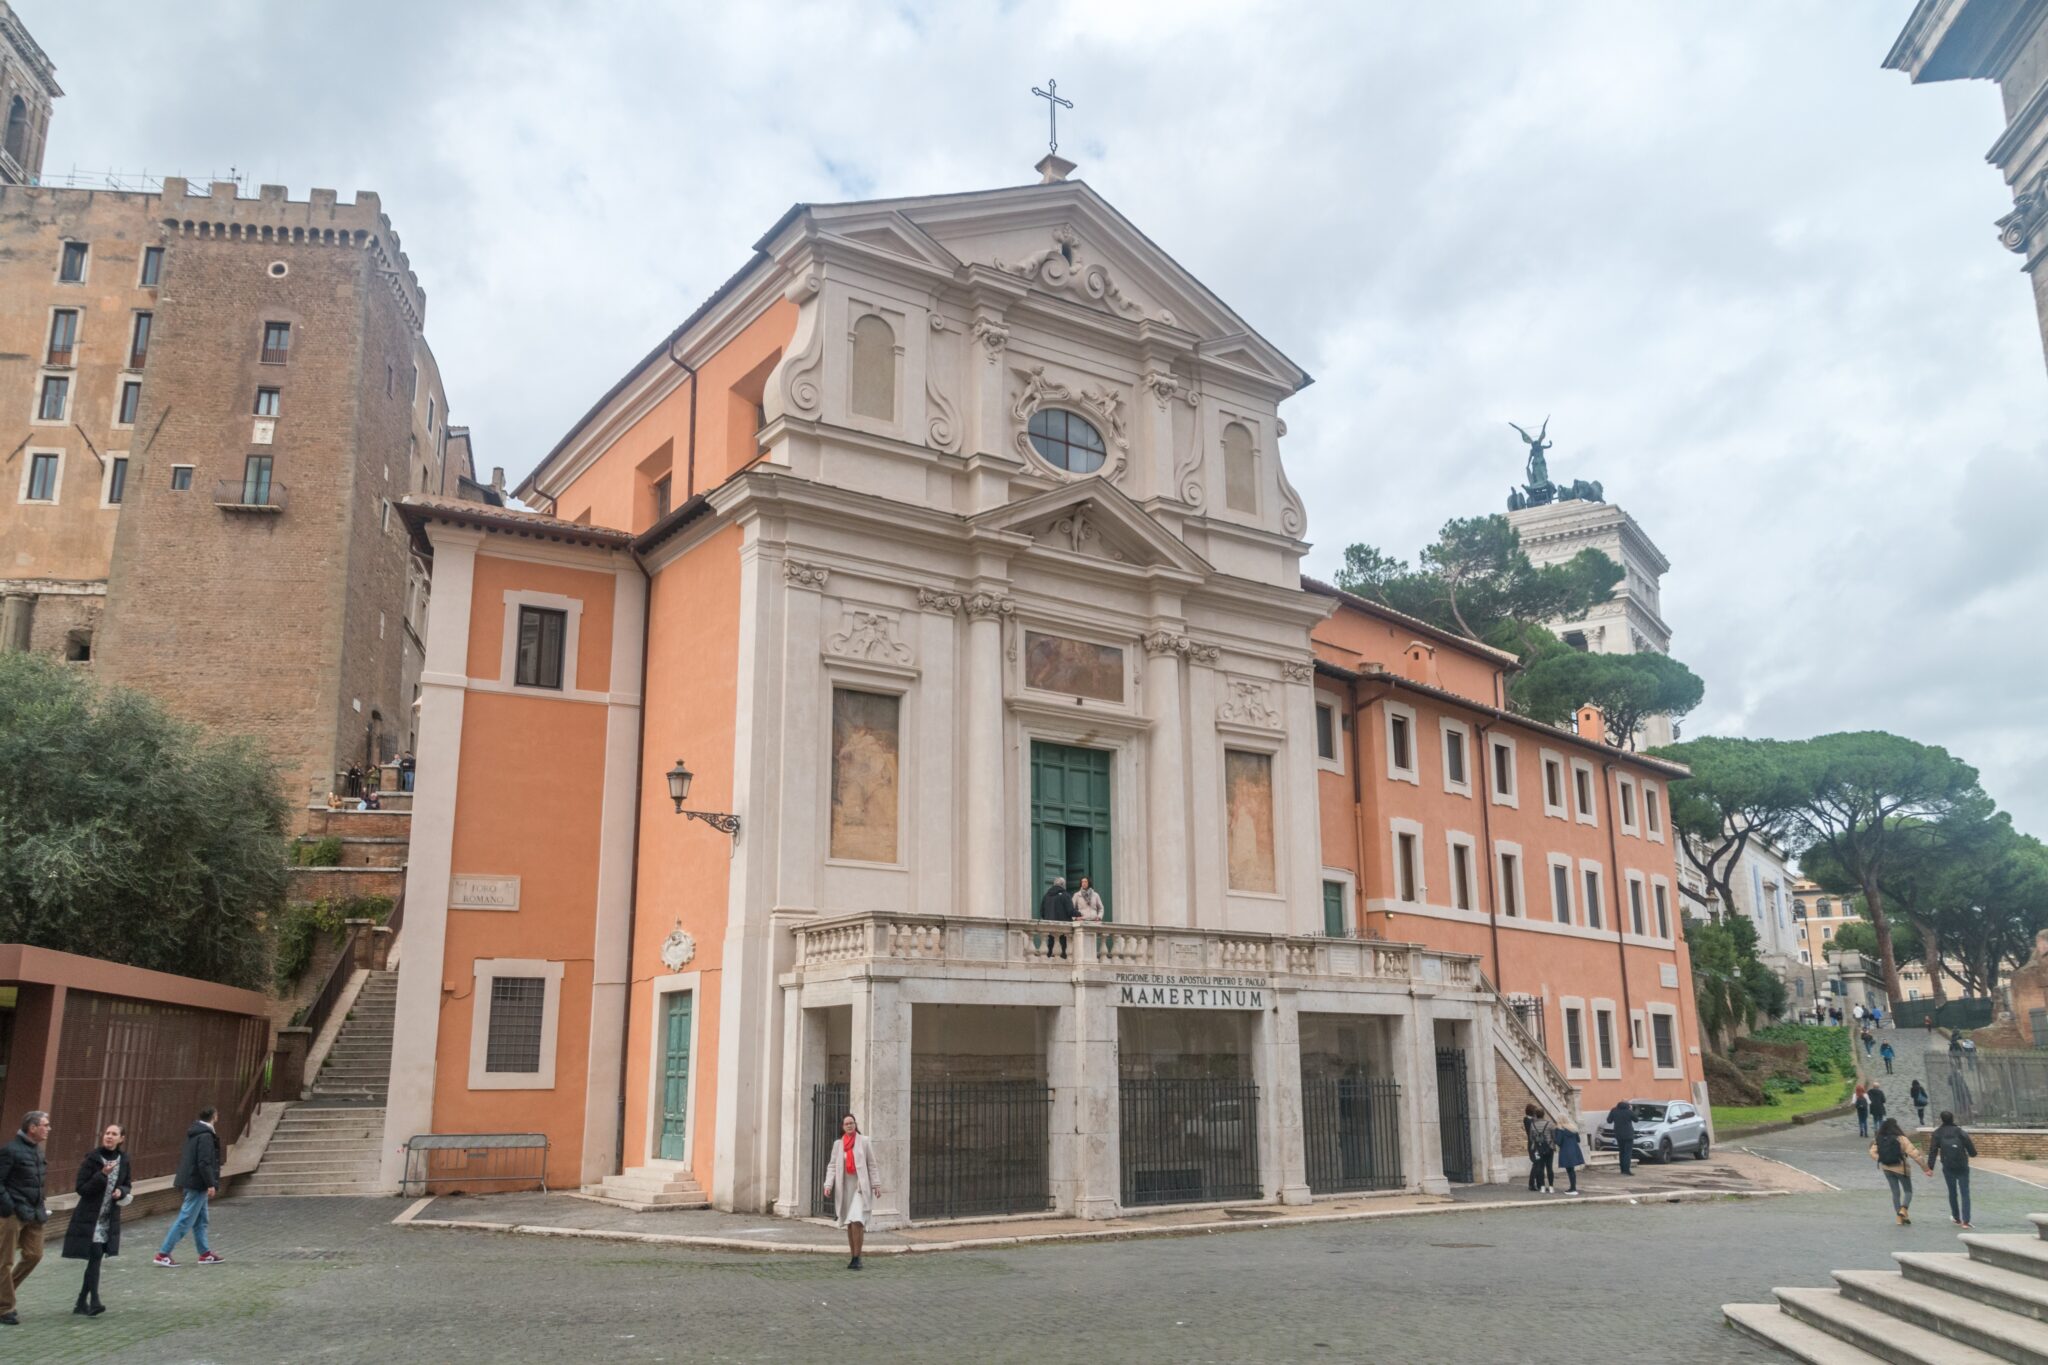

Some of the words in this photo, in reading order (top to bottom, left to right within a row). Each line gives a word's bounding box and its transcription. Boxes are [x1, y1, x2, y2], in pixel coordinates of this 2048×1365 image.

[463, 895, 504, 904] ROMANO
[1115, 973, 1149, 983] PRIGIONE
[1152, 975, 1164, 984] DEI
[1178, 976, 1212, 985] APOSTOLI
[1213, 977, 1236, 986] PIETRO
[1245, 977, 1267, 987] PAOLO
[1121, 986, 1262, 1007] MAMERTINUM
